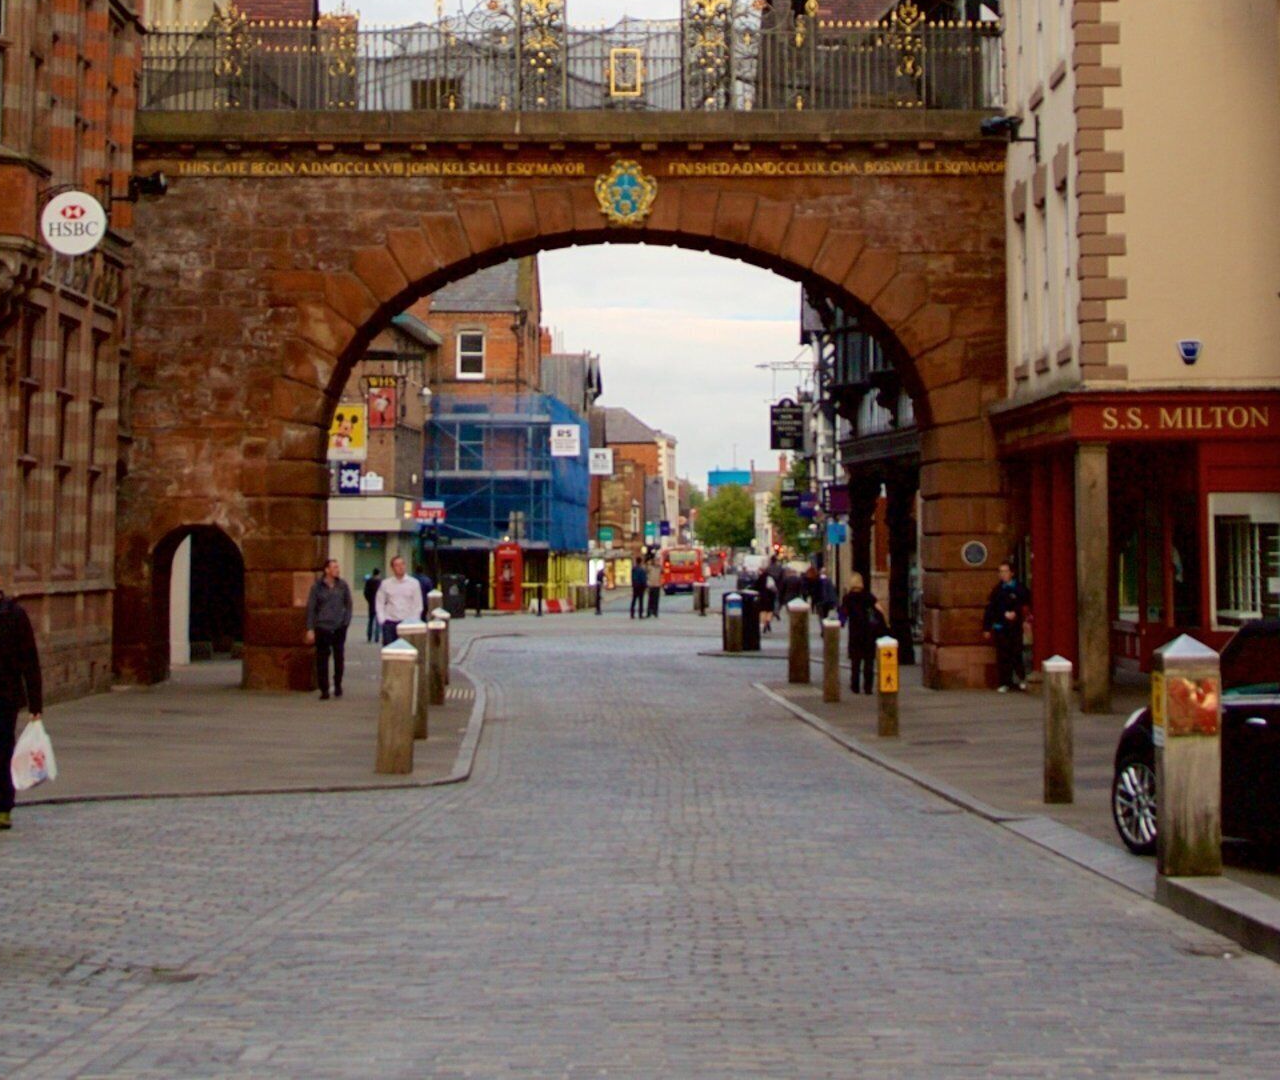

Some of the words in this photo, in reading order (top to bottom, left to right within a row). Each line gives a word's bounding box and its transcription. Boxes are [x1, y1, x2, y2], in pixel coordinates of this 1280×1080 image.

[178, 161, 210, 175] THIS
[212, 161, 249, 175] GATE
[250, 161, 294, 175] BEGUN
[406, 161, 440, 177] JOHN
[442, 161, 503, 176] KELSALL
[535, 161, 585, 175] MAYOR
[668, 161, 729, 176] FINISHED
[864, 160, 933, 175] BOSWELL
[48, 220, 99, 237] HSBC
[1102, 406, 1150, 430] S.S.
[1159, 405, 1269, 430] MILTON
